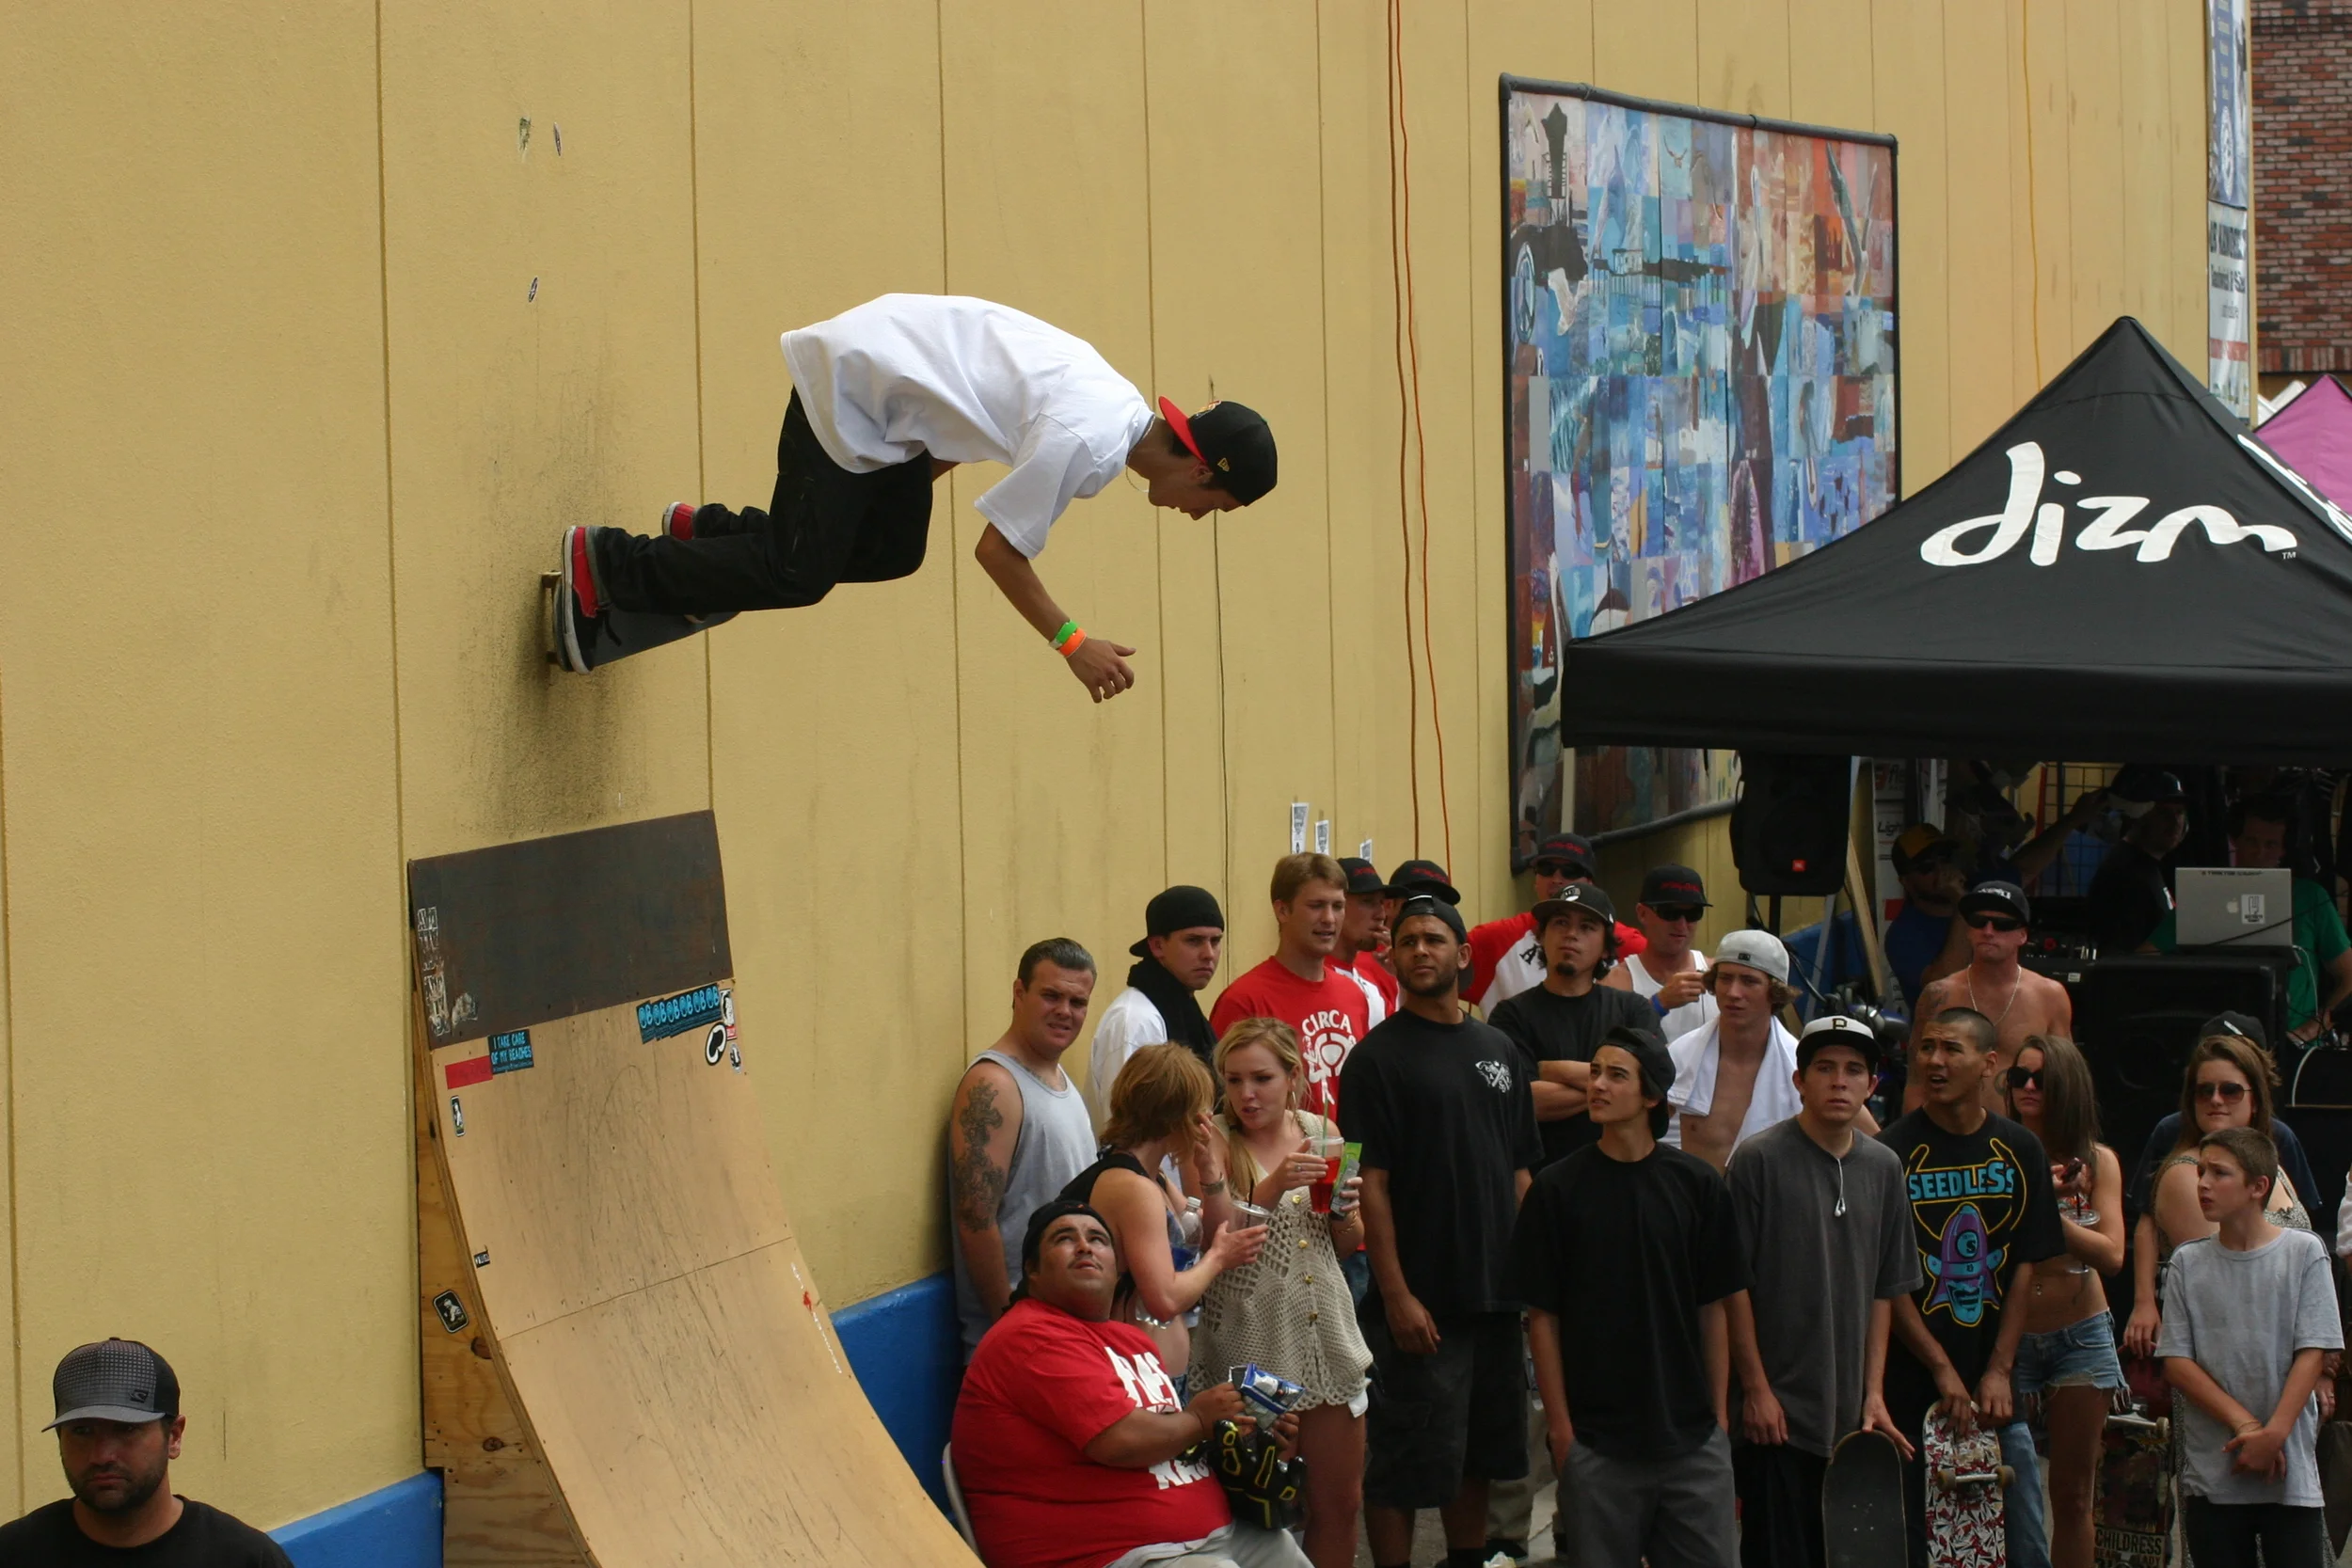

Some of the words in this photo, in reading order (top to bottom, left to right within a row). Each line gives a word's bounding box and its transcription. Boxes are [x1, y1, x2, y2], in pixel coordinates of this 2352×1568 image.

[1920, 441, 2297, 566] dizm
[1302, 1009, 1353, 1037] CIRCA
[1832, 1018, 1848, 1031] P
[511, 1031, 526, 1047] CARE
[1908, 1162, 2015, 1199] SEEDLESS
[2095, 1528, 2162, 1555] CHILDRESS
